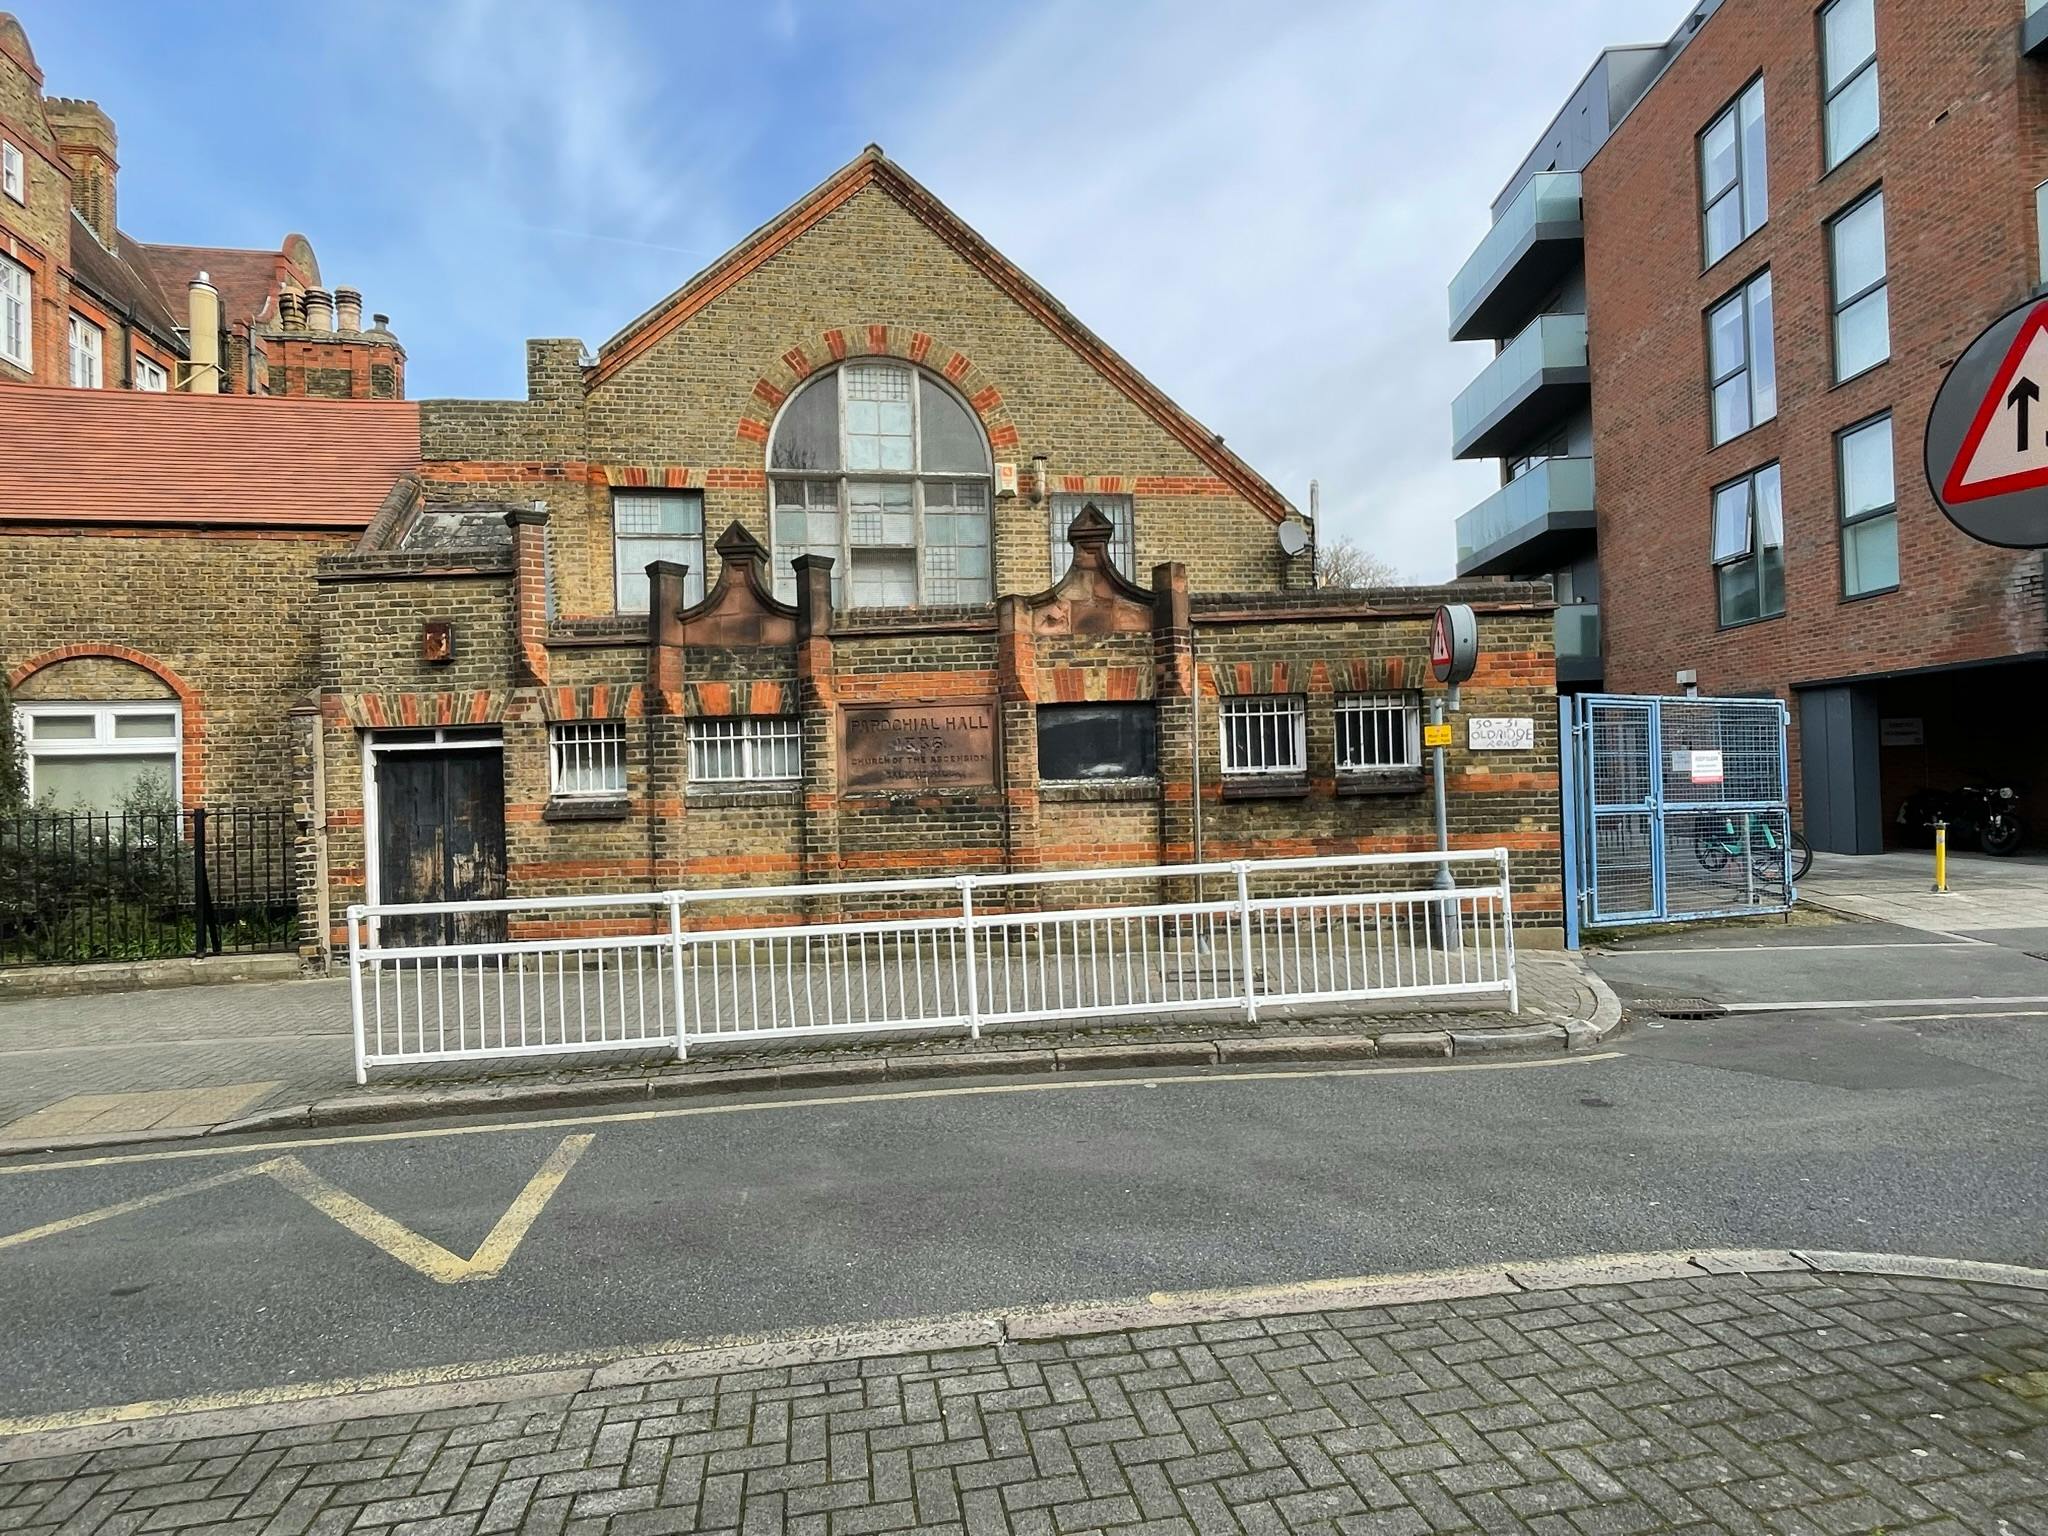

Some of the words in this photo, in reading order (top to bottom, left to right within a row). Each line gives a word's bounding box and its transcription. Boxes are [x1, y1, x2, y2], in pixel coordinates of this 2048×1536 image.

[850, 717, 940, 734] PAROCHIAL
[945, 715, 989, 731] HALL
[1475, 719, 1493, 730] 50
[1471, 728, 1534, 742] OLDRIDGE
[1487, 740, 1520, 748] ROAD
[851, 755, 891, 767] CHURCH
[892, 756, 904, 765] OF
[906, 756, 927, 765] THE
[930, 754, 989, 764] ASCENSION
